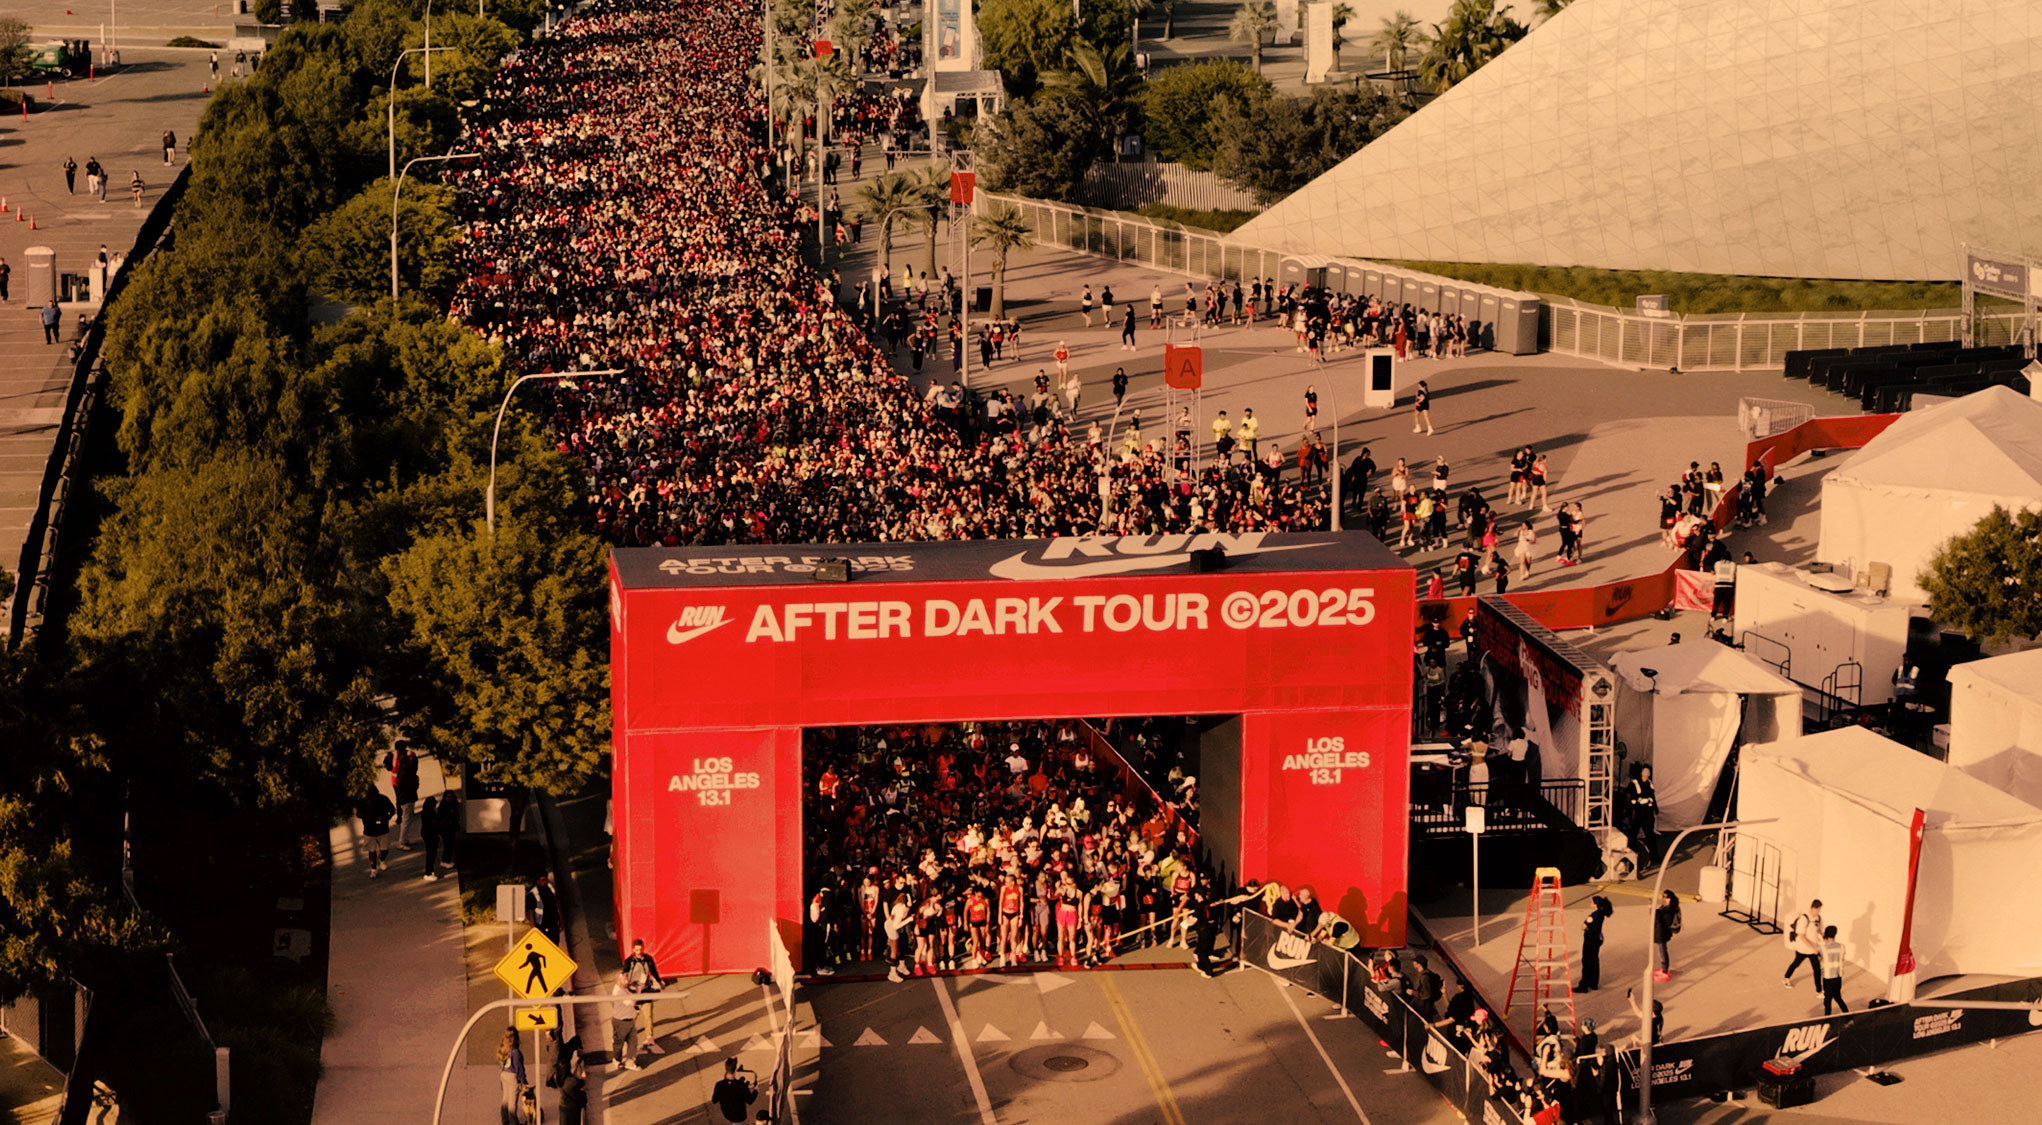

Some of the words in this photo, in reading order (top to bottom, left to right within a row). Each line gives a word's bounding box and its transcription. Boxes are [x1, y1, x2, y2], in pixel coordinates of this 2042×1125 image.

[1179, 359, 1197, 377] A
[1040, 533, 1268, 560] RUN
[658, 556, 792, 570] AFTER
[659, 563, 776, 576] TOUR
[1612, 585, 1634, 602] RUN
[678, 605, 727, 628] RUN
[745, 600, 912, 643] AFTER
[924, 596, 1063, 637] DARK
[1073, 592, 1210, 633] TOUR
[1220, 588, 1376, 631] ©2025
[1307, 736, 1345, 753] LOS
[694, 756, 733, 774] LOS
[1282, 752, 1371, 771] ANGELES
[668, 772, 760, 792] ANGELES
[1309, 768, 1342, 785] 13.1
[697, 789, 731, 806] 13.1
[1276, 930, 1312, 960] RUN
[1781, 1023, 1831, 1053] RUN
[1655, 1062, 1675, 1071] DARK
[1680, 1073, 1692, 1081] 13.1
